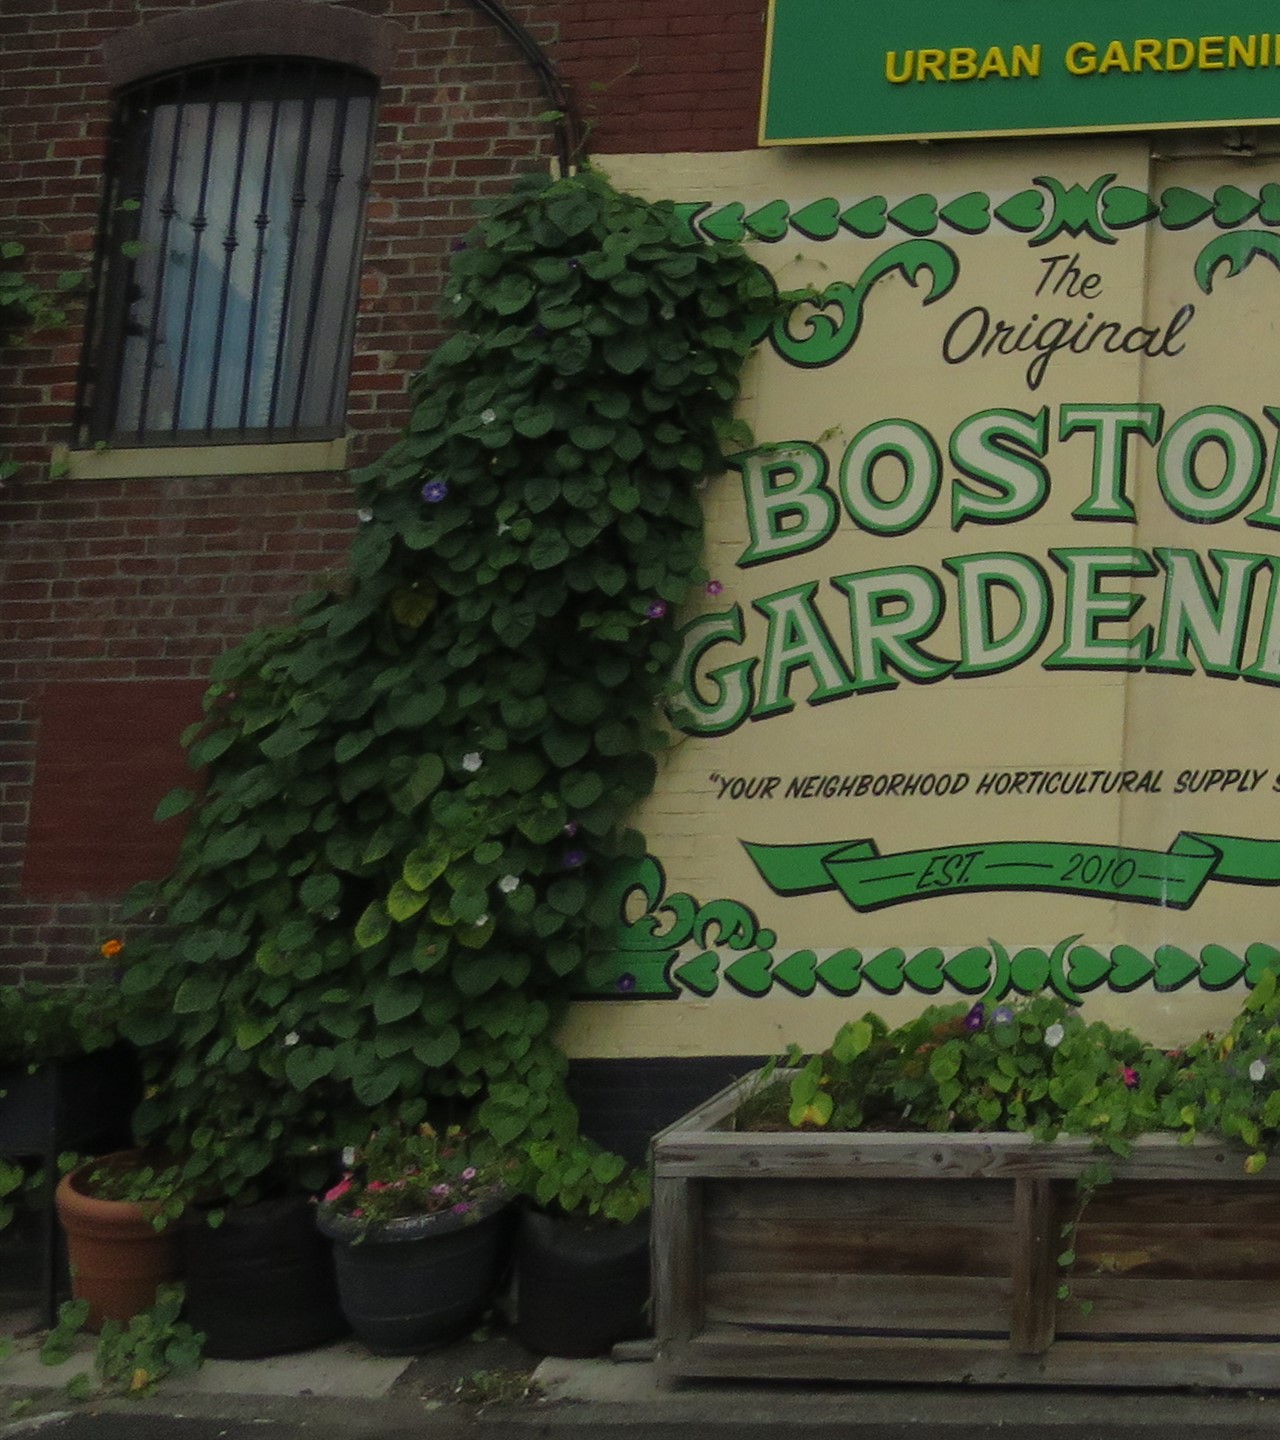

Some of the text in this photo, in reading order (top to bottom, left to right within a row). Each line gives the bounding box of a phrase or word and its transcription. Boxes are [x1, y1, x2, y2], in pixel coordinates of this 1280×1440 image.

[885, 45, 1041, 83] URBAN
[1035, 252, 1103, 299] The
[942, 303, 1196, 391] Original
[784, 772, 971, 799] NEIGHBORHOOD
[975, 769, 1164, 796] HORTICULTURAL
[1173, 768, 1269, 794] SUPPLY
[915, 850, 1137, 889] EST. 2010
